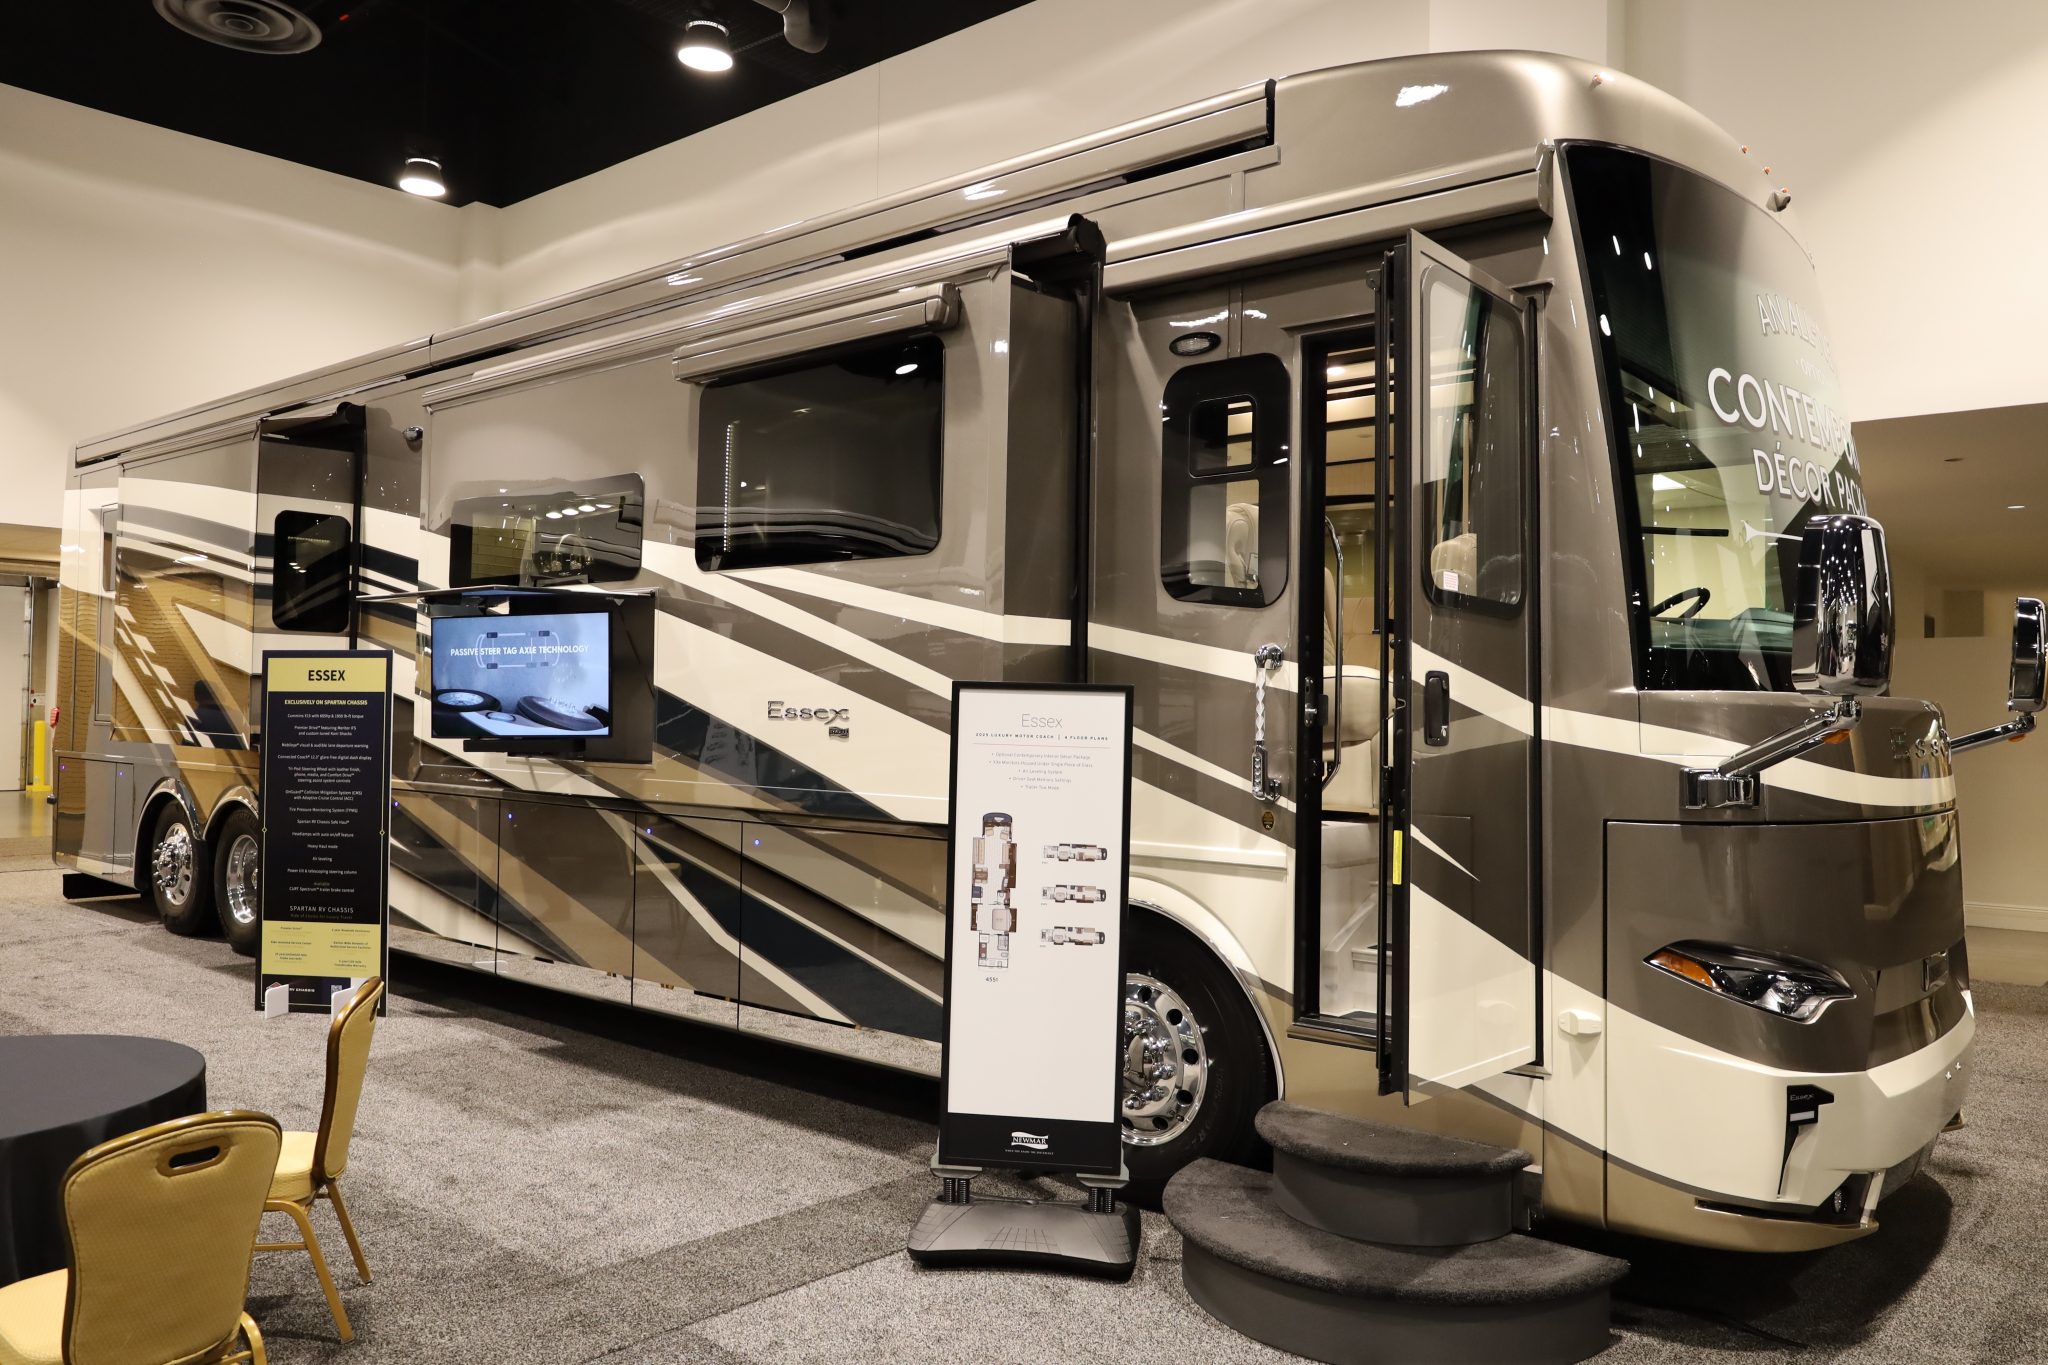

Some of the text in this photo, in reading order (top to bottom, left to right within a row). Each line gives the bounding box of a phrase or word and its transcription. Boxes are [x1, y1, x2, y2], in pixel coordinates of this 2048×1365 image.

[1757, 294, 1788, 335] AN
[1707, 367, 1860, 475] CONTEMPO
[1753, 441, 1868, 516] DÉCOR PACK
[450, 644, 589, 656] PASSIVE STEER TAG AXLE TECHNOLOGY
[308, 669, 346, 681] ESSEX
[767, 700, 850, 725] Essex
[1021, 713, 1063, 728] Essex
[1012, 1136, 1047, 1145] NEWMAR
